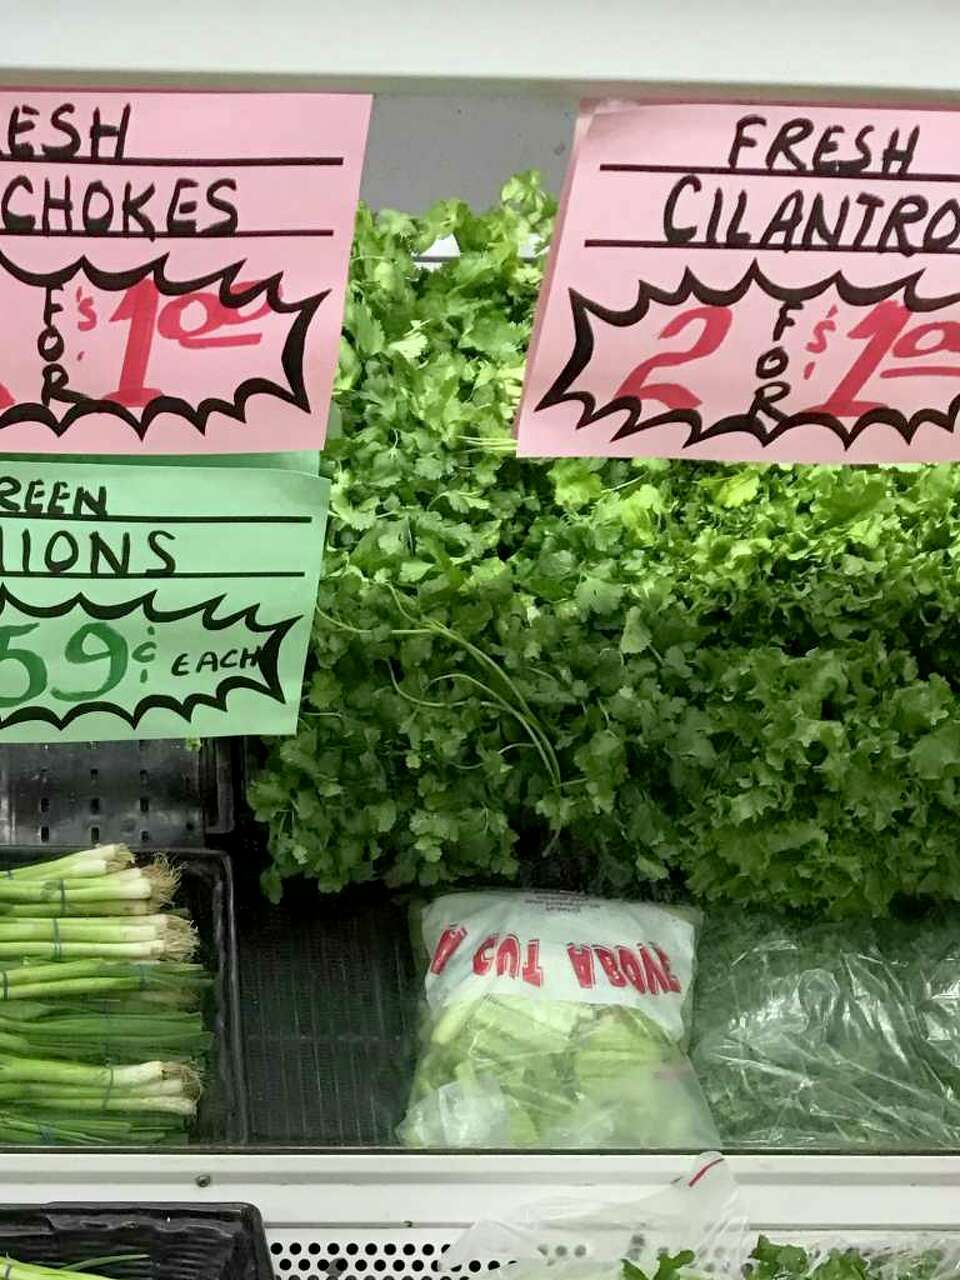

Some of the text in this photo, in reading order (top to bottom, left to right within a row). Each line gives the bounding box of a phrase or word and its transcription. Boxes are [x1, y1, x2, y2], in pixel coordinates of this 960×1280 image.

[728, 114, 920, 174] FRESH
[663, 174, 960, 256] CILANTRO
[613, 305, 734, 410] 2
[171, 645, 260, 677] EACH
